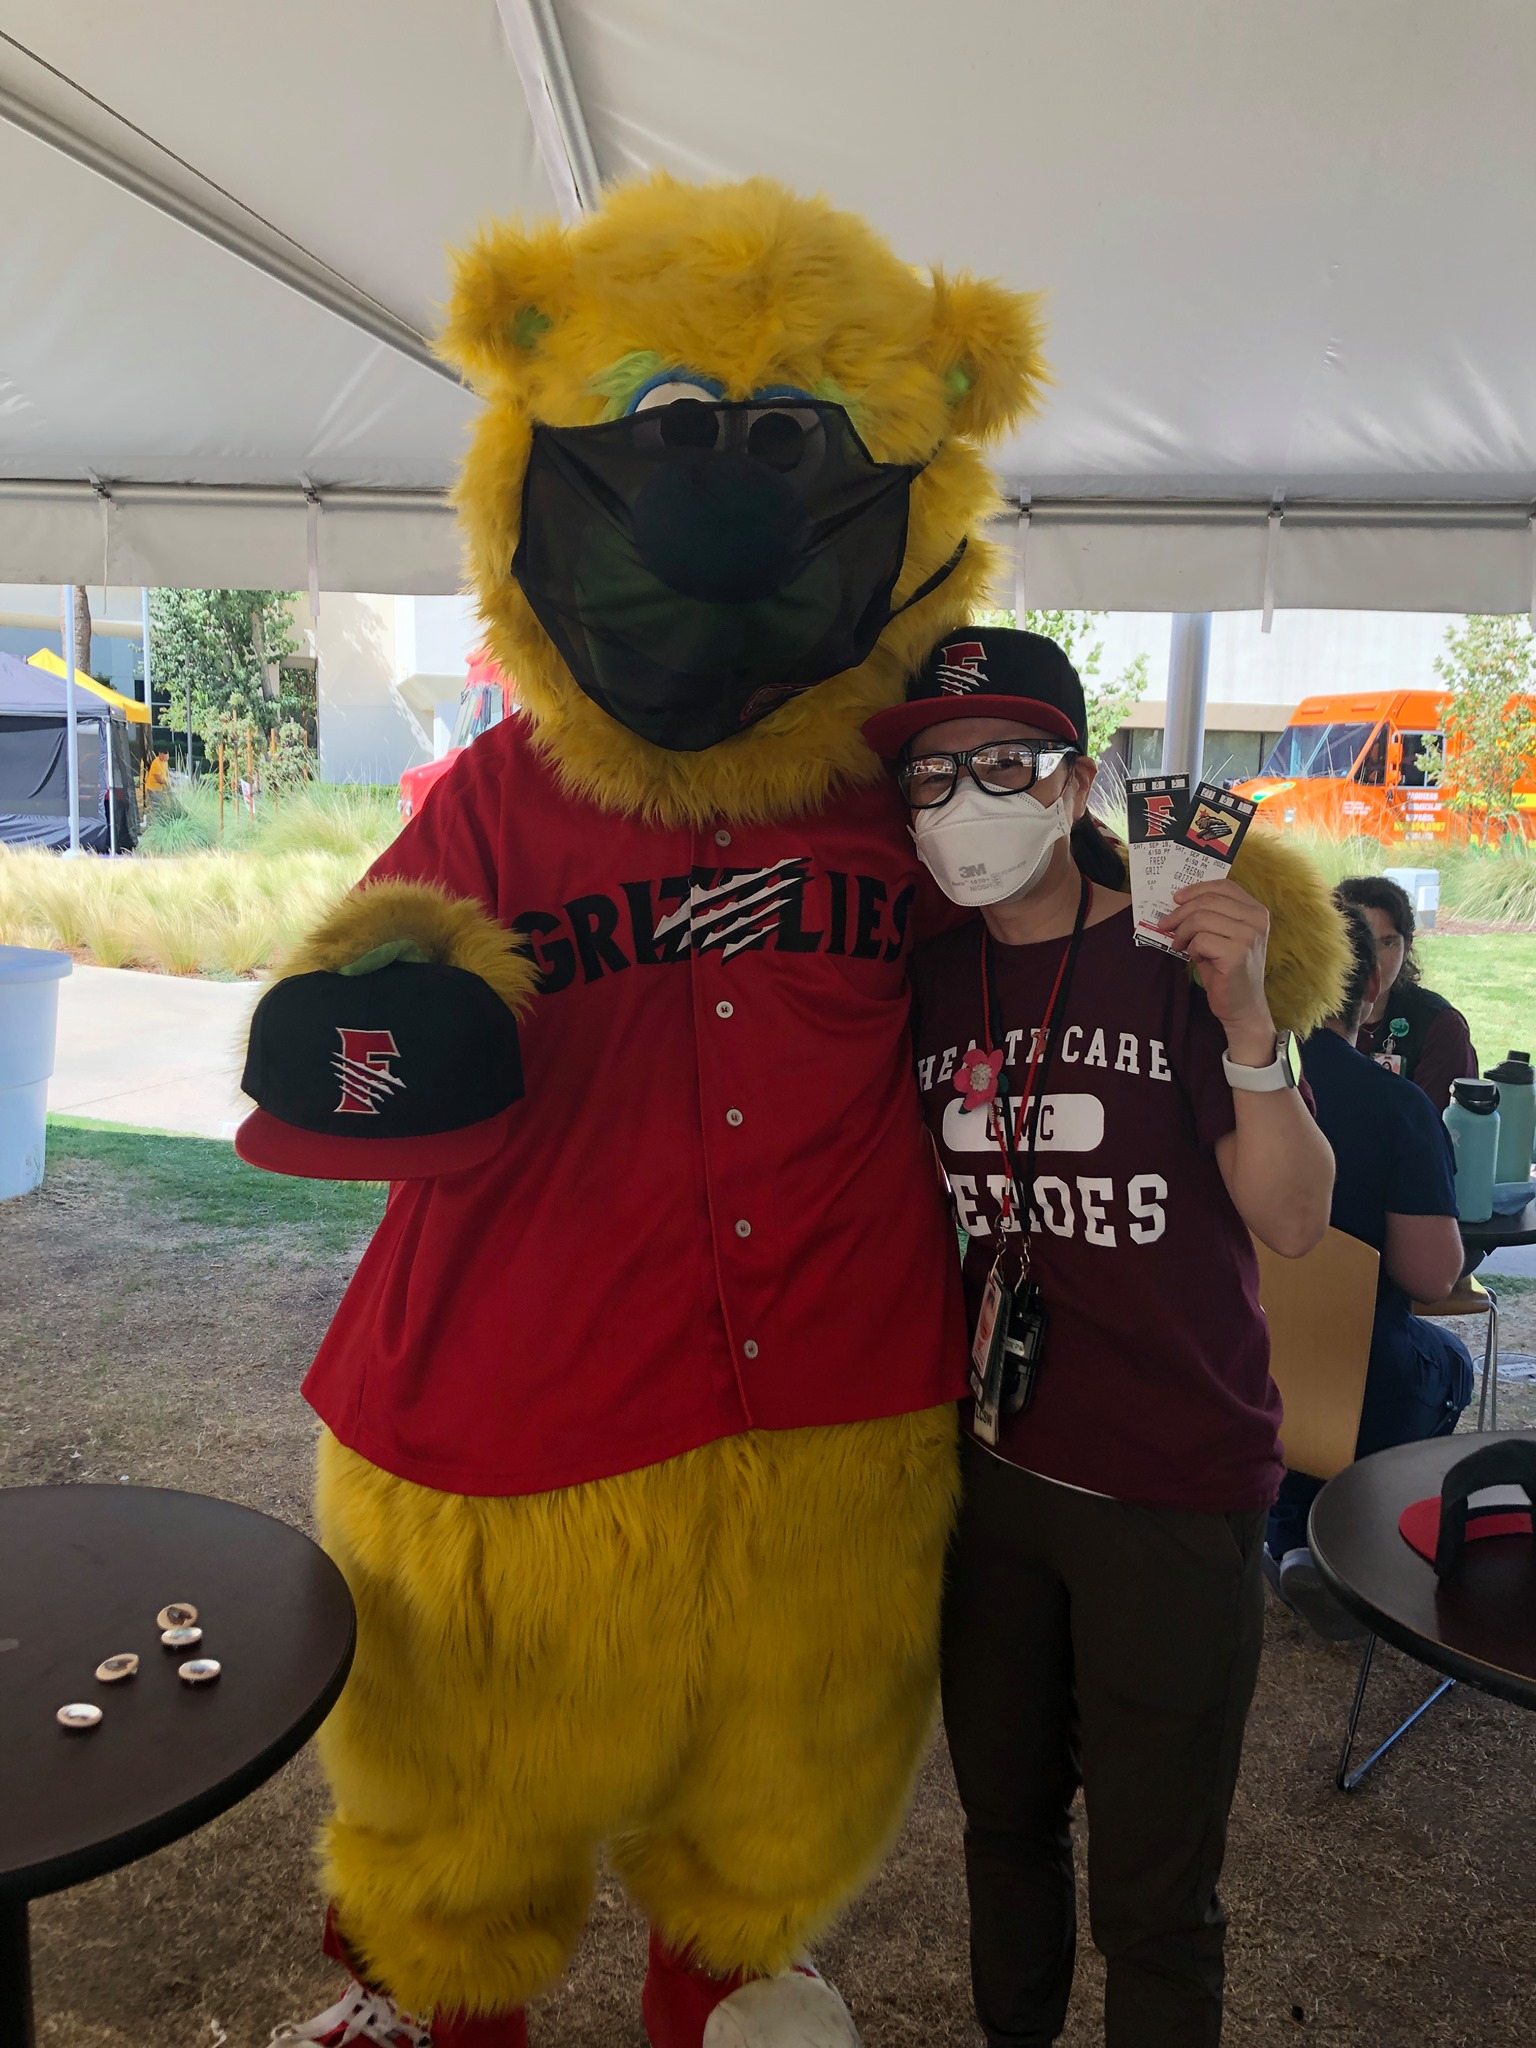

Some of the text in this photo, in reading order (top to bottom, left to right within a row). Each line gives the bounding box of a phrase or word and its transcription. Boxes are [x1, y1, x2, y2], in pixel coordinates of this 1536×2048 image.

[959, 863, 987, 878] 3M
[1144, 866, 1163, 875] GRIZ
[1173, 871, 1204, 885] GRIZZ
[1182, 863, 1205, 879] FRESNO
[511, 857, 916, 995] GRIZZLIES
[917, 1025, 1172, 1093] HETH CARE
[949, 1173, 1169, 1248] EROES
